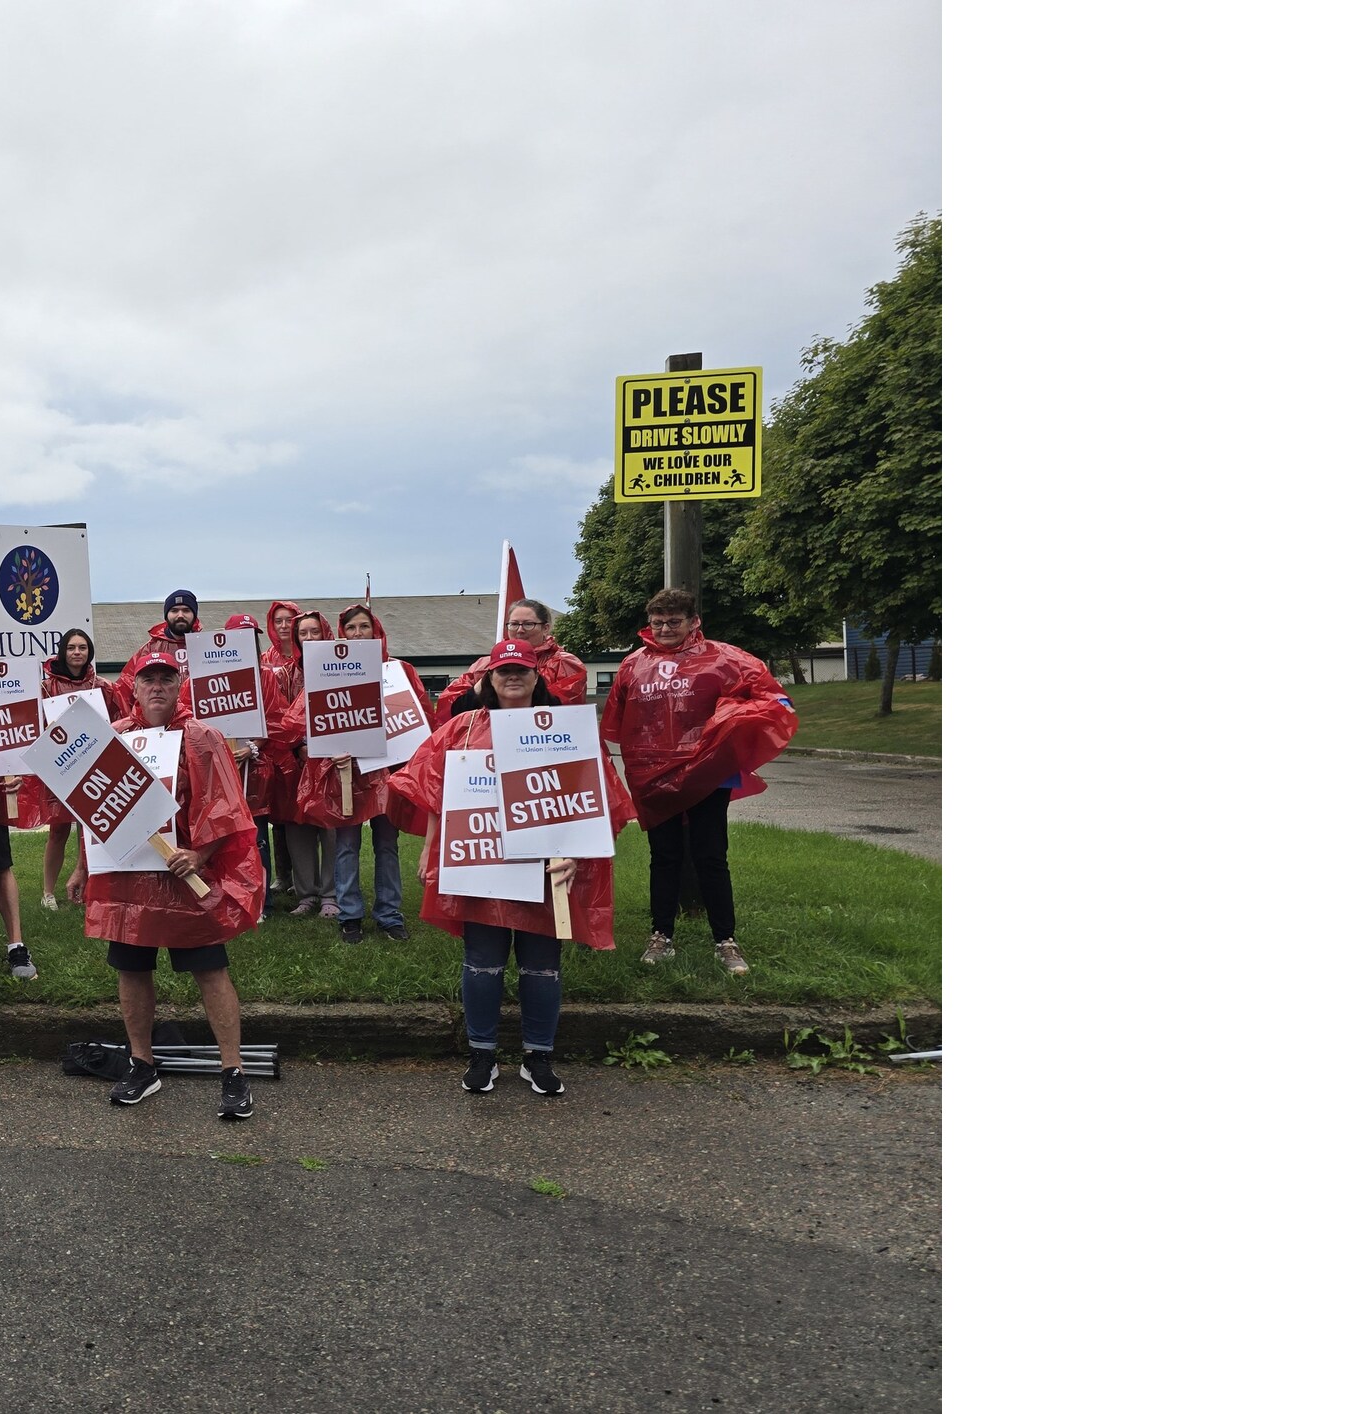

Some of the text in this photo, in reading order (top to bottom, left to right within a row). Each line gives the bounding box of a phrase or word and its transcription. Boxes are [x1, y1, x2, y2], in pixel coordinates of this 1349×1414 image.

[632, 382, 746, 419] PLEASE
[630, 423, 747, 448] DRIVE SLOWLY
[643, 453, 732, 470] WE LOVE OUR
[654, 471, 721, 487] CHILDREN
[208, 675, 230, 694] ON
[198, 690, 254, 715] STRIKE
[326, 690, 352, 710] ON
[314, 706, 379, 732] STRIKE
[82, 768, 112, 800] ON
[525, 769, 561, 794] ON
[90, 765, 148, 833] STRIKE
[510, 790, 599, 824] STRIKE
[468, 811, 499, 834] ON
